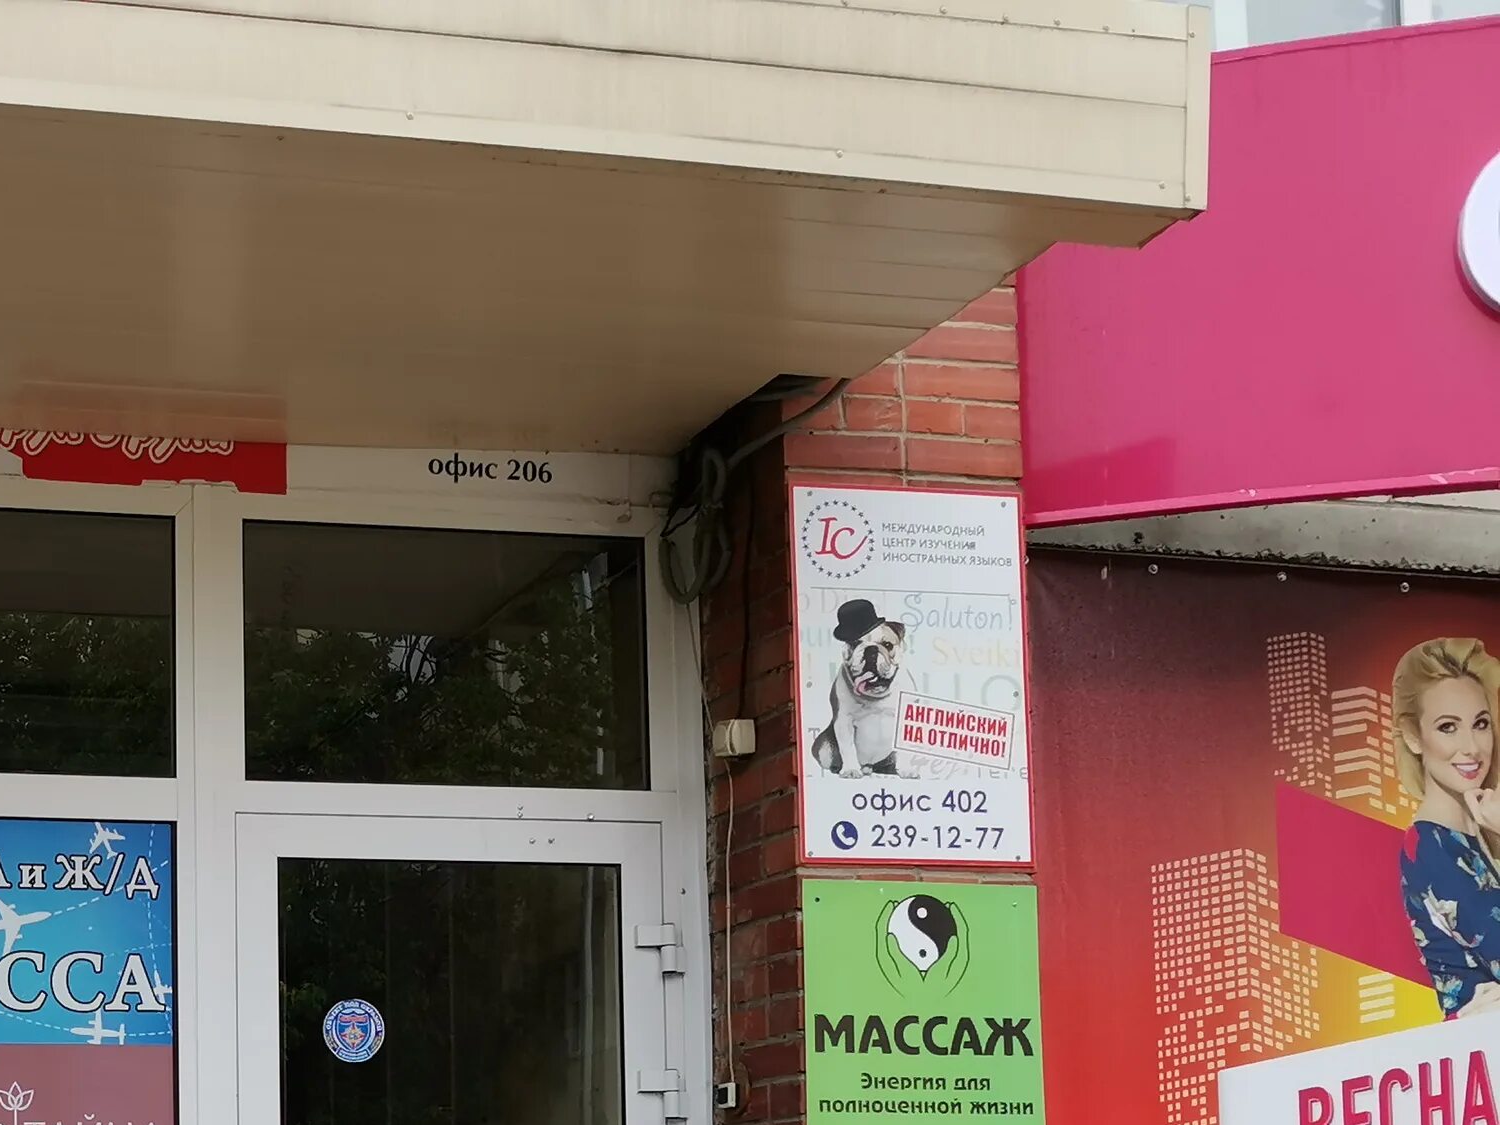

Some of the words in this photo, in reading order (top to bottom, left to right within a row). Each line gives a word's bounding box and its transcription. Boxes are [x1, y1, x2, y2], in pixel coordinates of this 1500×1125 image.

[428, 452, 499, 483] офис
[507, 459, 553, 483] 206
[882, 522, 984, 536] МЕЖДУНАРОДНЫЙ
[882, 538, 916, 548] ЦЕНТР
[920, 539, 976, 550] ИЗУЧЕНИЯ
[882, 552, 966, 564] ИНОСТРАННЫХ
[970, 556, 1012, 566] ЯЗЫКОВ
[904, 703, 1008, 737] АНГЛИЙСКИЙ
[903, 724, 923, 743] НА
[928, 728, 1007, 758] ОТЛИЧНО!
[852, 788, 932, 816] офис
[942, 790, 988, 813] 402
[871, 824, 1004, 849] 239-12-77
[19, 864, 46, 889] и
[55, 853, 160, 900] Ж/Д
[814, 1013, 1034, 1056] МАССАЖ
[861, 1073, 947, 1091] Энергия
[954, 1076, 991, 1091] для
[819, 1098, 962, 1115] полноценной
[970, 1102, 1034, 1115] жизни
